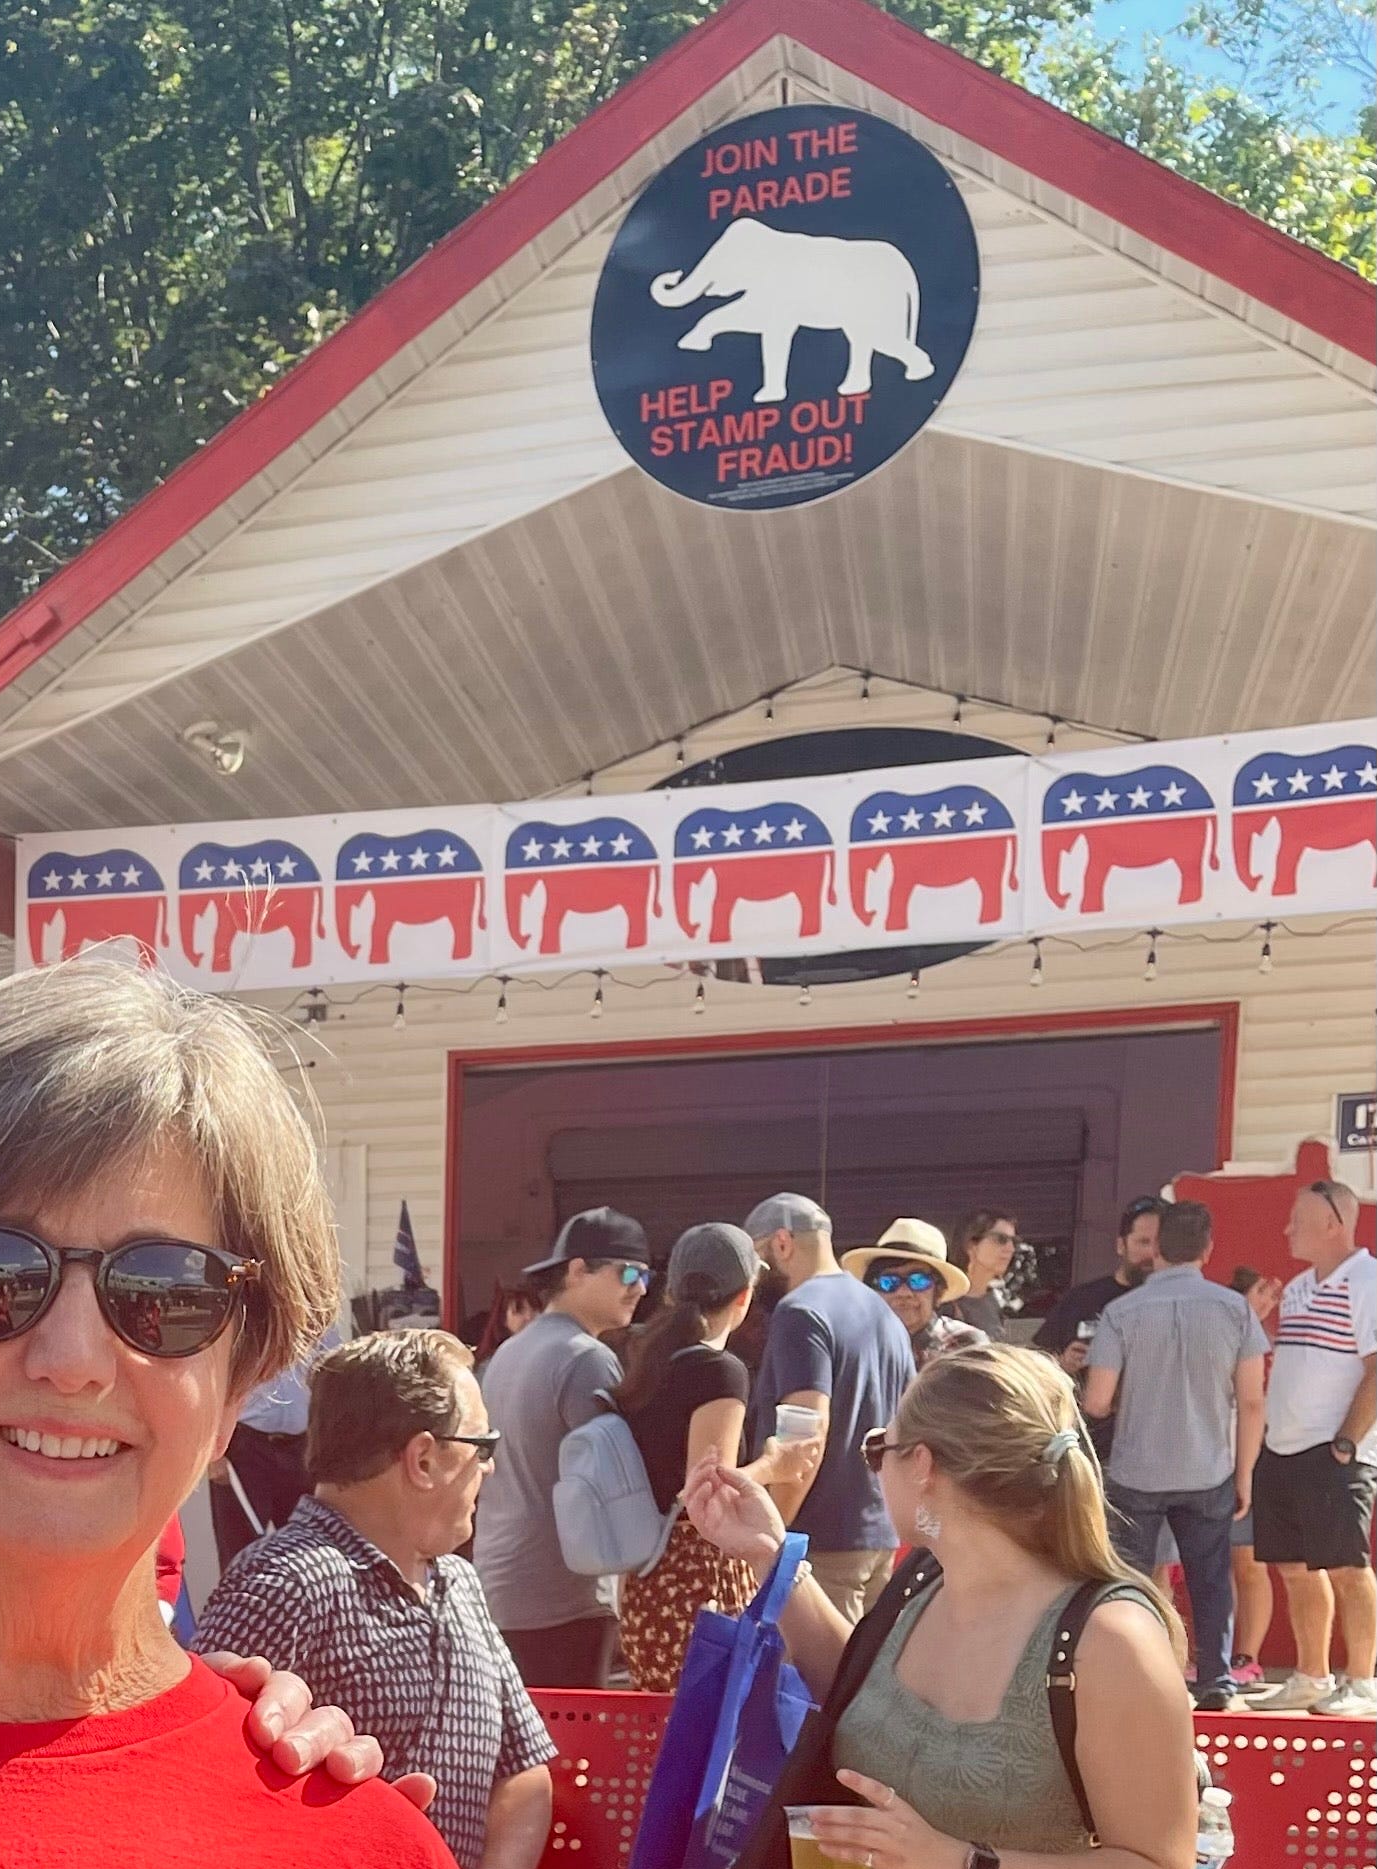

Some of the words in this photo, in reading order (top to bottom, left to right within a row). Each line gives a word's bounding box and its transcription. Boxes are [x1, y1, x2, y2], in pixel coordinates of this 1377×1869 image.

[701, 137, 778, 178] JOIN
[789, 123, 858, 158] THE
[709, 168, 852, 220] PARADE
[640, 379, 734, 422] HELP
[650, 408, 780, 456] STAMP
[790, 393, 871, 435] OUT
[716, 433, 853, 482] FRAUD!
